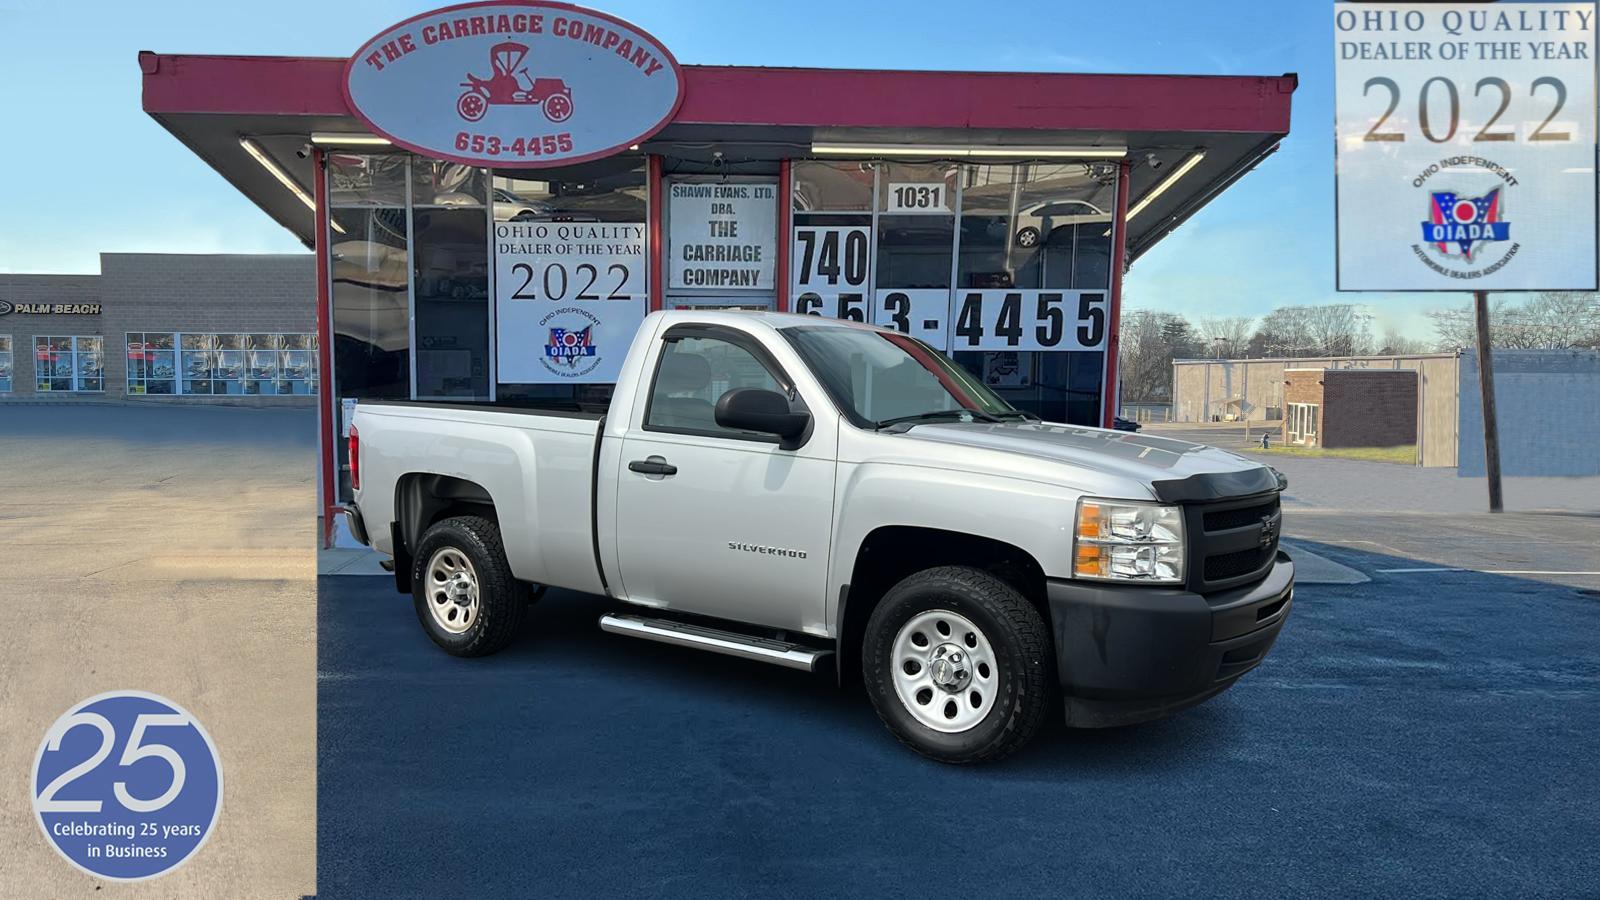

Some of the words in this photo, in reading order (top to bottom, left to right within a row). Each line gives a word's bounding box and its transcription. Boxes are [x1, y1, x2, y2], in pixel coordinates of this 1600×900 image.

[1336, 10, 1425, 31] OHIO
[1442, 10, 1592, 35] QUALITY
[365, 33, 416, 72] THE
[422, 14, 543, 45] CARRIAGE
[552, 17, 664, 77] COMPANY
[1340, 42, 1432, 60] DEALER
[1439, 42, 1469, 60] OF
[1475, 42, 1522, 60] THE
[1528, 42, 1589, 60] YEAR
[1363, 76, 1571, 143] 2022
[455, 132, 573, 156] 653-4455
[1412, 164, 1439, 188] OHIO
[1440, 155, 1519, 188] INDEPENDENT
[673, 186, 711, 198] SHAWN
[754, 187, 775, 199] LTD.
[894, 187, 940, 208] 1031
[711, 203, 736, 215] DBA.
[497, 226, 548, 239] OHIO
[557, 226, 643, 241] QUALITY
[708, 221, 738, 238] THE
[1433, 224, 1495, 240] OIADA
[500, 243, 552, 254] DEALER
[555, 244, 573, 255] OF
[576, 244, 603, 255] THE
[607, 244, 641, 255] YEAR
[683, 244, 762, 262] CARRIAGE
[797, 230, 868, 286] 740
[511, 263, 631, 301] 2022
[683, 269, 760, 286] COMPANY
[1450, 269, 1482, 279] DEALERS
[15, 304, 51, 314] PALM
[54, 304, 100, 314] BEACH
[551, 346, 588, 356] OIADA
[728, 541, 807, 559] SILVERADO
